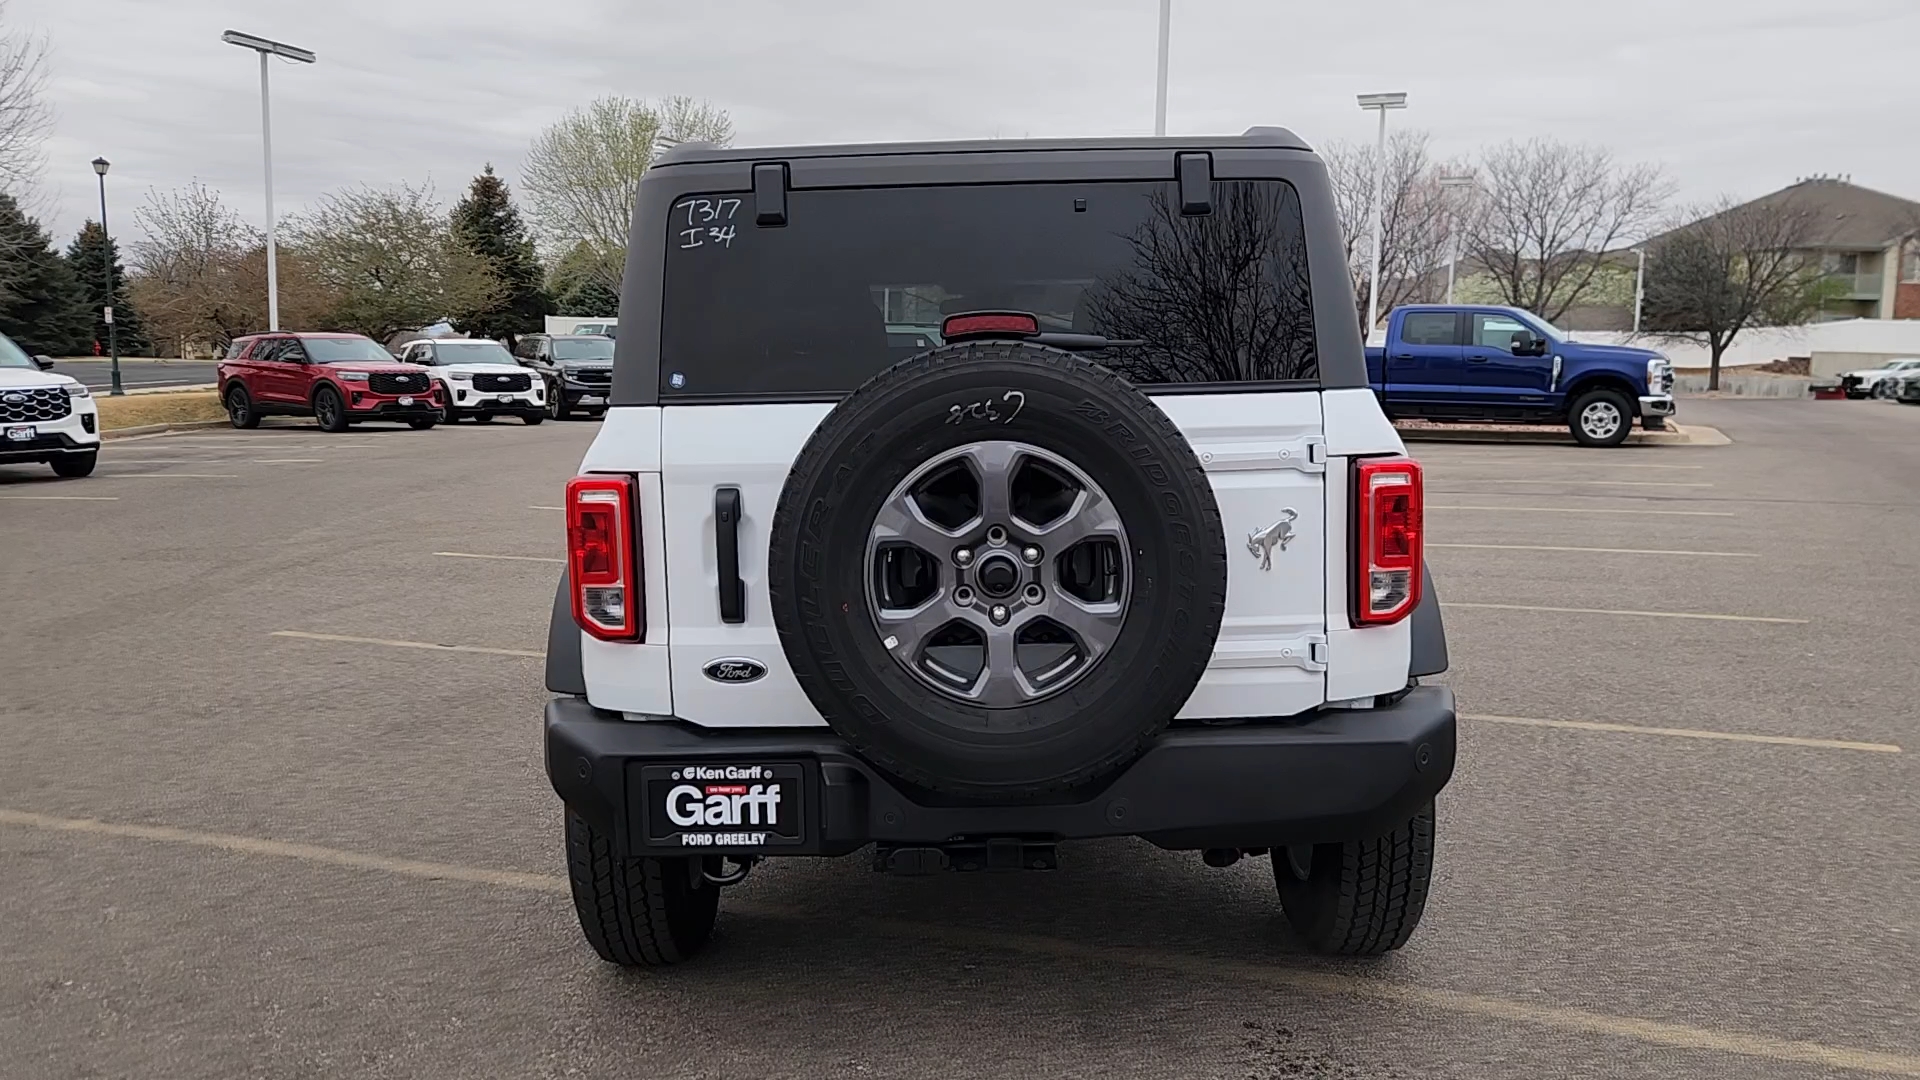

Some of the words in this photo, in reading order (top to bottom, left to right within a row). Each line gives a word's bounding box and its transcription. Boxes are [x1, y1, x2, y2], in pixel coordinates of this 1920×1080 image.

[1072, 399, 1195, 692] BRIDGESTONE
[717, 663, 752, 678] Ford
[696, 767, 724, 779] Ken
[725, 766, 762, 779] Garff
[666, 784, 781, 826] Garff
[682, 834, 713, 846] FORD
[715, 833, 766, 845] GREELEY
